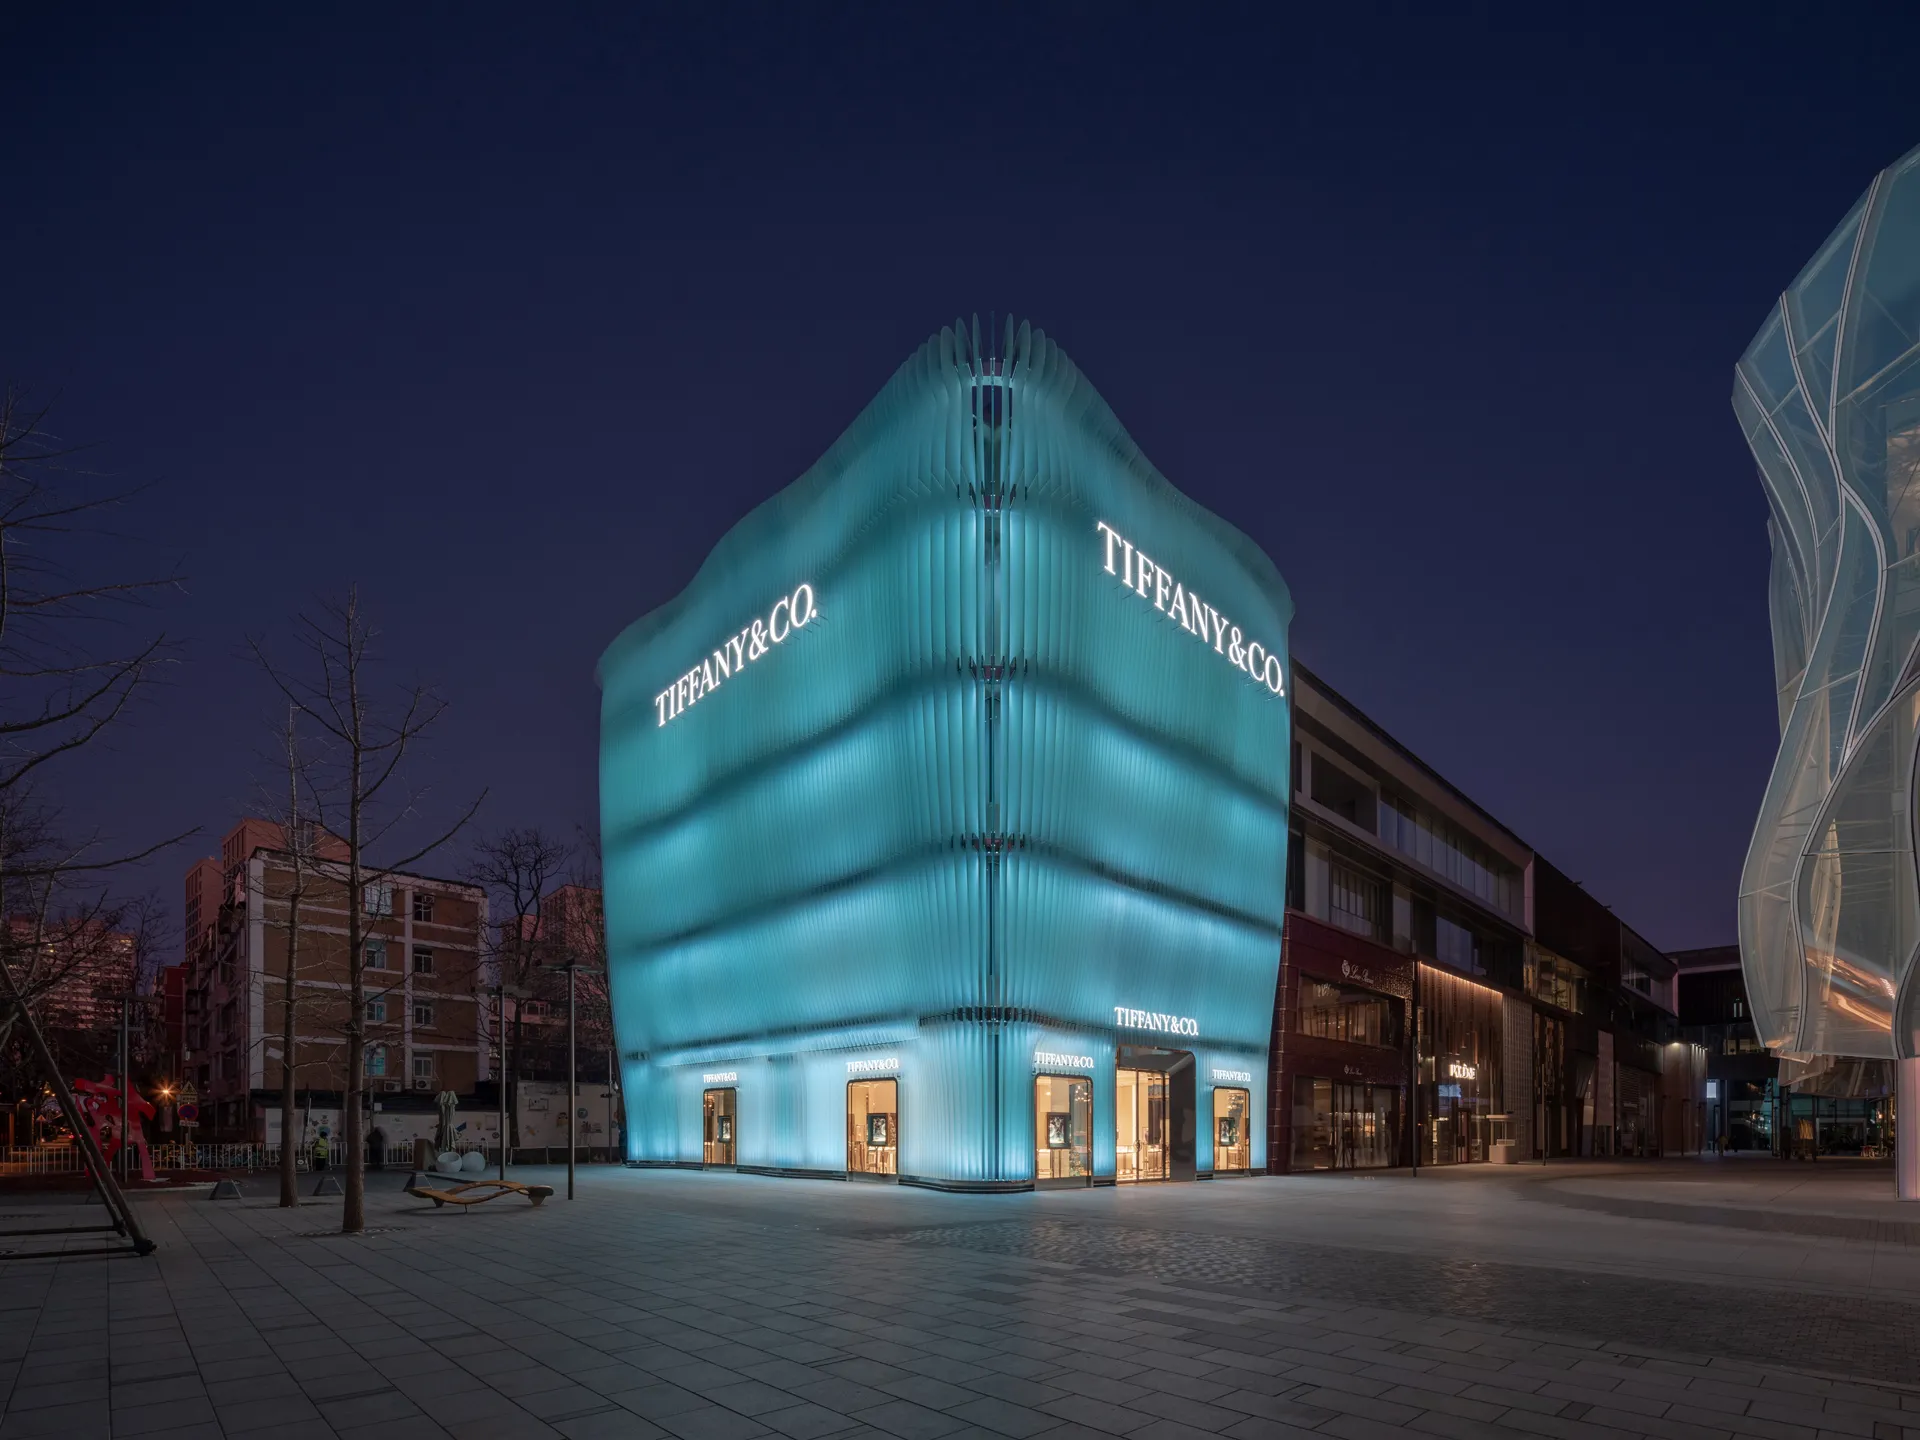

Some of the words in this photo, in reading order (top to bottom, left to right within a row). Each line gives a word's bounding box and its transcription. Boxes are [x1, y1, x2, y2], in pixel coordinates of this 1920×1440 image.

[1097, 521, 1284, 697] TIFFANY&CO.
[655, 584, 817, 727] TIFFANY&CO.
[1114, 1006, 1199, 1036] TIFFANY&CO.
[846, 1058, 899, 1072] TIFFANY&CO.
[1035, 1051, 1094, 1069] TIFFANY&CO.
